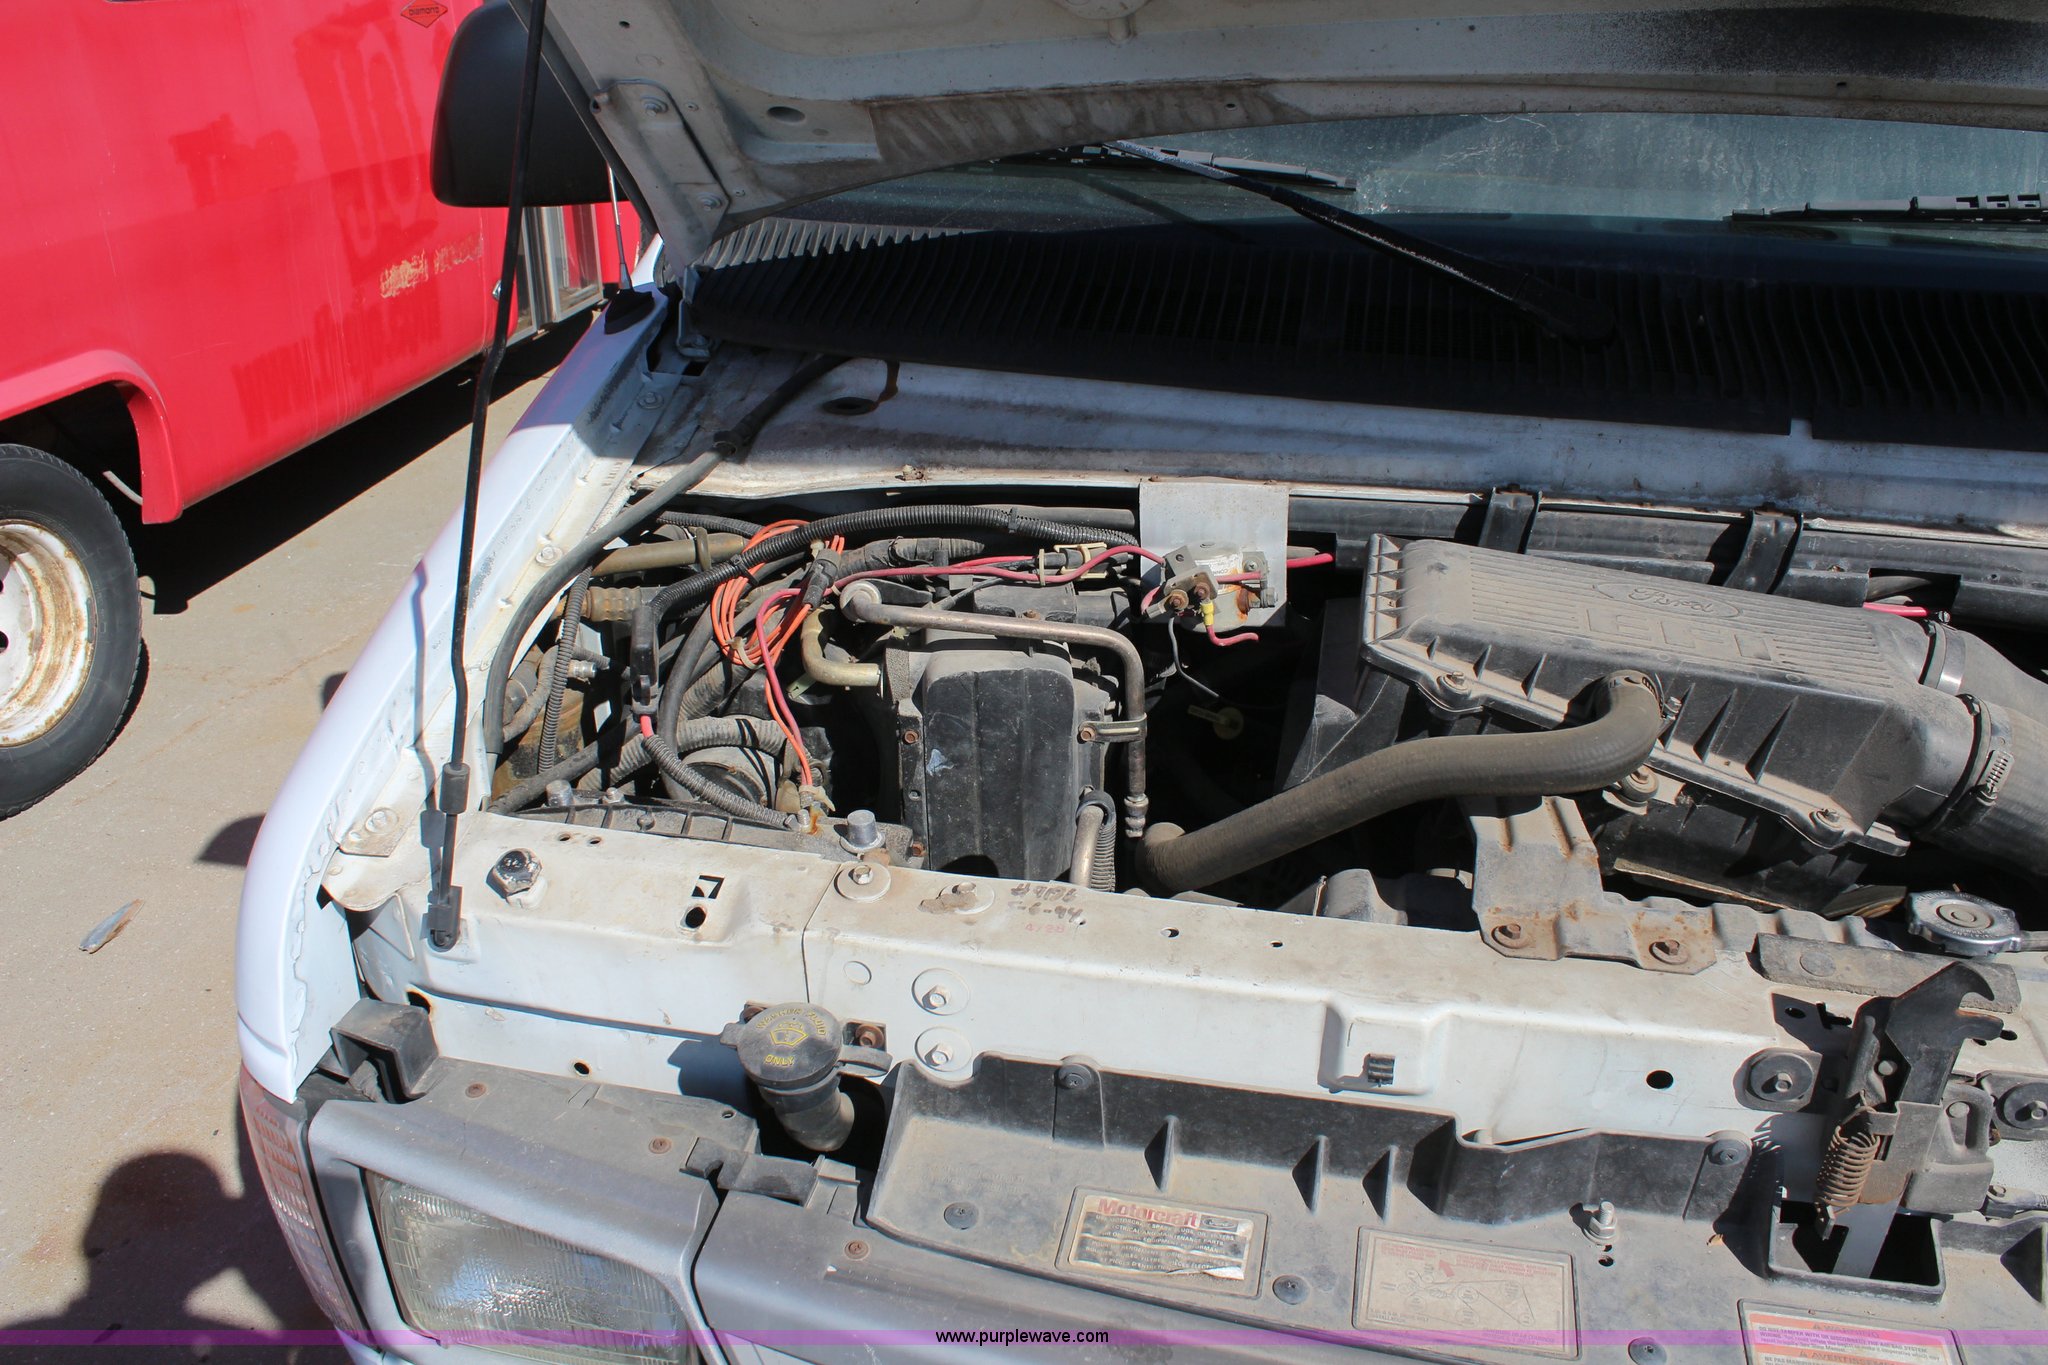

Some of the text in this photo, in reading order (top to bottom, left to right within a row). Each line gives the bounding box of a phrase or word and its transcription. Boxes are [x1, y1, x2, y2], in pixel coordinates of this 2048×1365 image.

[1628, 587, 1714, 613] Ford
[763, 1054, 795, 1066] ONLY
[1097, 1198, 1198, 1228] Motorcraft
